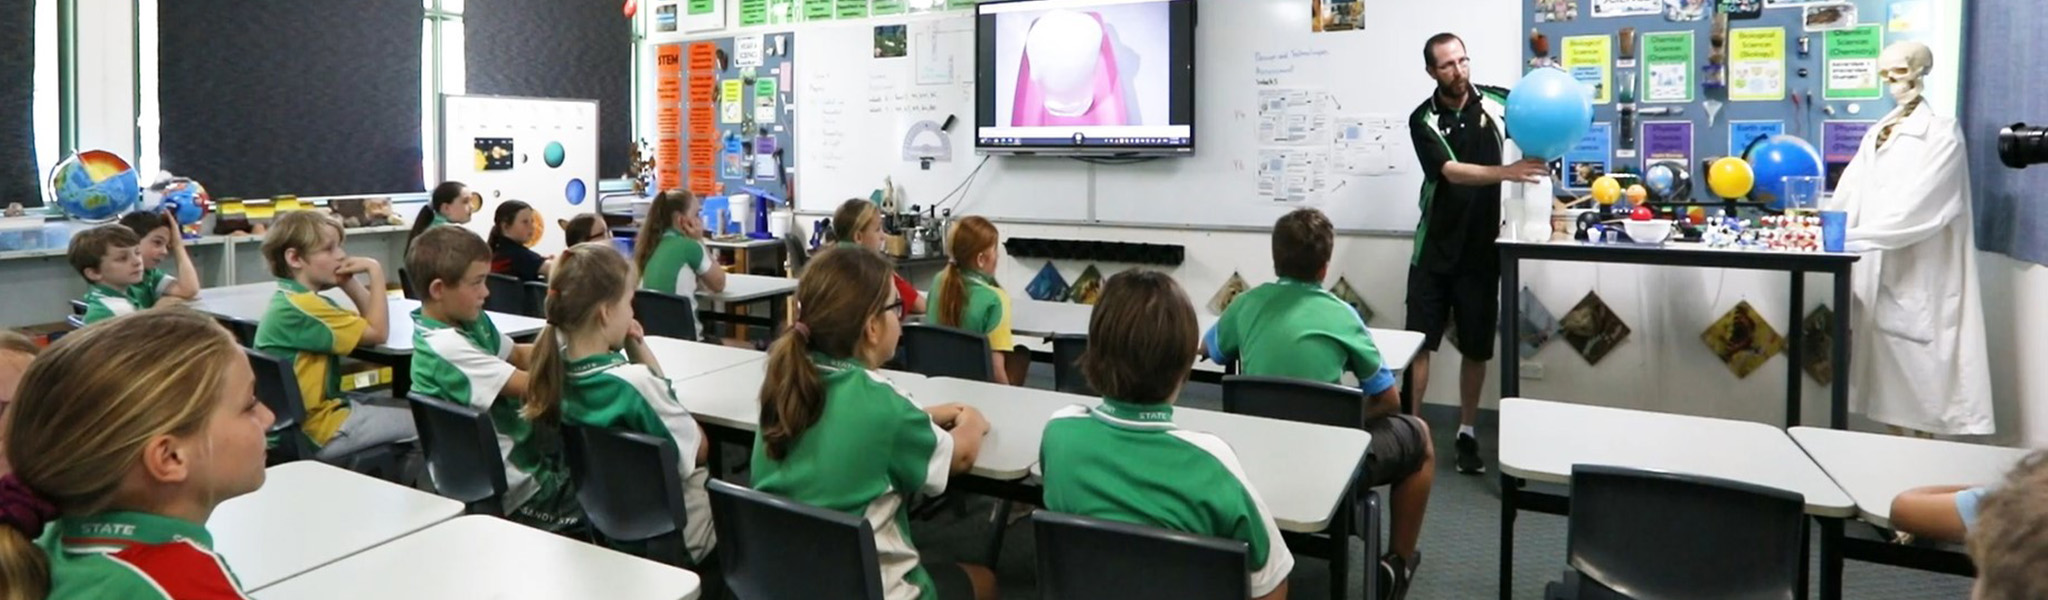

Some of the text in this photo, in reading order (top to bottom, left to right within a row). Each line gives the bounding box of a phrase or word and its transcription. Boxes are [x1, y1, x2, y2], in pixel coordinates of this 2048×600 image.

[658, 54, 679, 66] STEM
[1140, 412, 1167, 420] STATE
[81, 523, 136, 535] STATE
